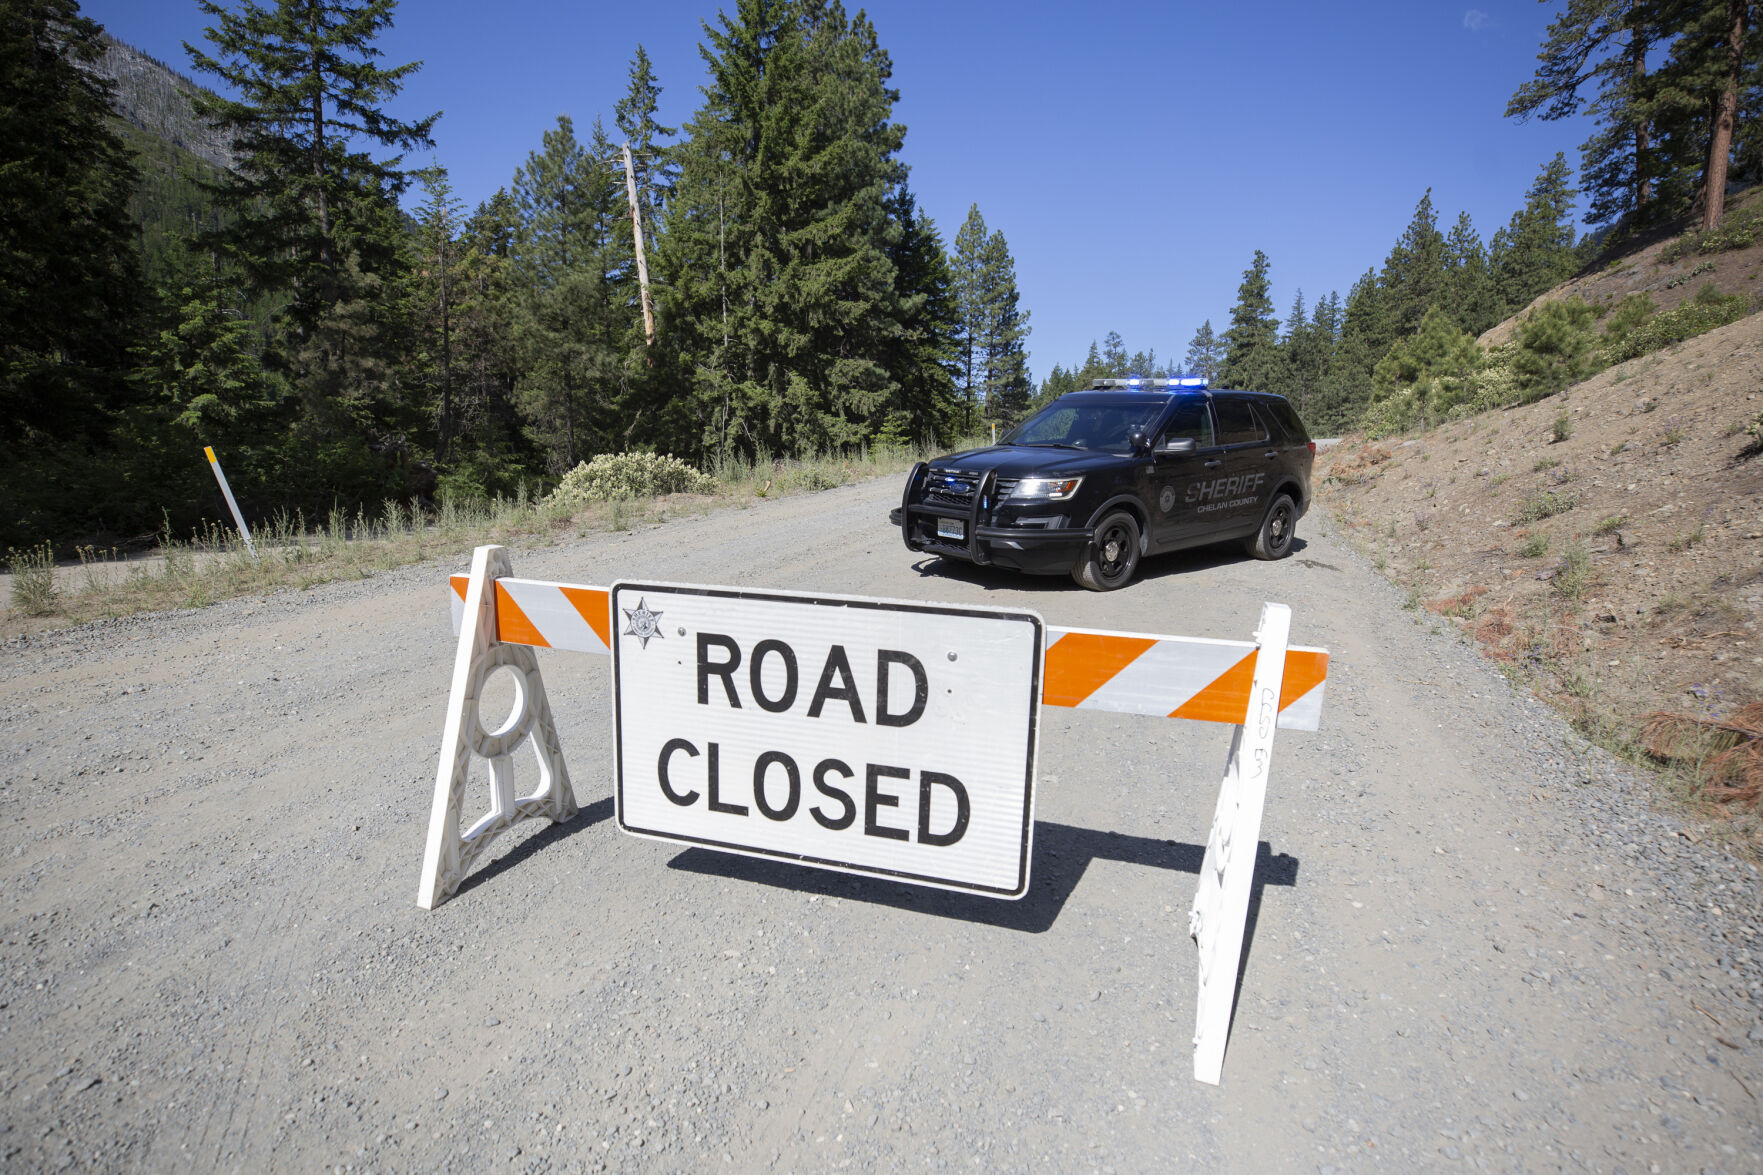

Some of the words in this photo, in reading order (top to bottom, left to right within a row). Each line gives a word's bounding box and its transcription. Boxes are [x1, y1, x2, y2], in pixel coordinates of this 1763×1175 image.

[1186, 473, 1265, 503] SHERIFF
[1197, 502, 1228, 513] CHELAN
[1229, 496, 1259, 508] COUNTY
[696, 631, 928, 728] ROAD
[657, 737, 971, 847] CLOSED
